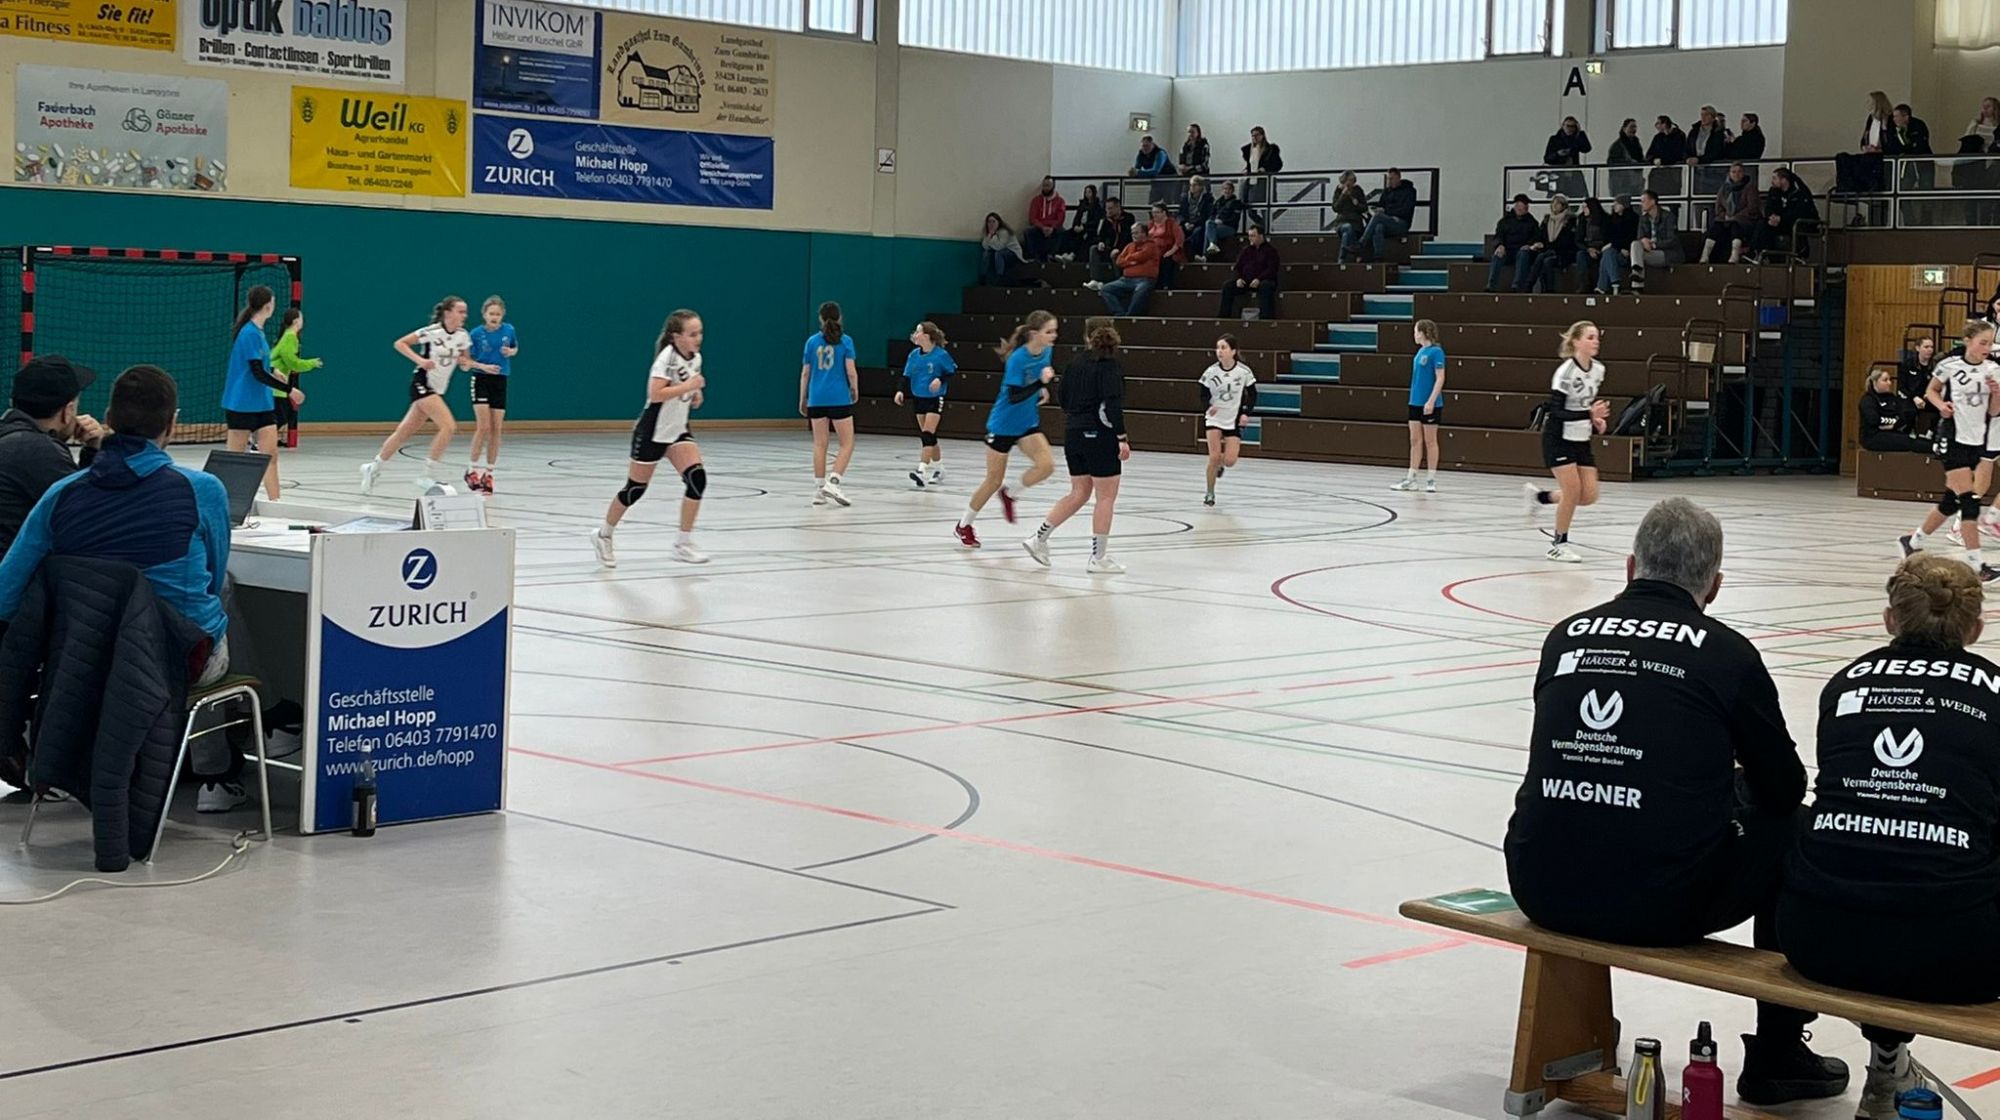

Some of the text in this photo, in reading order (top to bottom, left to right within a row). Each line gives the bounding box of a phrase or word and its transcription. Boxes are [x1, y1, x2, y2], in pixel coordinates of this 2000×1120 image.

[15, 14, 71, 35] Fitness
[97, 4, 154, 24] Sie fit!
[492, 3, 584, 36] INVIKOM
[199, 37, 235, 56] Brillen
[244, 42, 319, 65] Contactlinsen
[327, 51, 391, 72] Sportbrillen
[1563, 66, 1587, 97] A
[38, 101, 96, 116] Fauerbach
[340, 98, 425, 134] Weil KG
[40, 116, 94, 130] Apotheke
[156, 123, 208, 136] Apotheke
[357, 150, 376, 159] und
[377, 150, 433, 163] Gartenmarkt
[575, 155, 649, 174] Michael Hopp
[484, 165, 555, 187] ZURICH
[574, 171, 605, 184] Telefon
[817, 345, 835, 371] 13
[368, 600, 467, 628] ZURICH
[1566, 616, 1707, 649] GIESSEN
[1580, 654, 1627, 667] HÄUSER
[1628, 659, 1639, 668] &
[1642, 660, 1686, 679] WEBER
[1846, 658, 2000, 694] GIESSEN
[328, 685, 435, 709] Geschäftsstelle
[1867, 694, 1922, 706] HÄUSER
[1925, 697, 1935, 706] &
[1940, 697, 1988, 721] WEBER
[327, 708, 437, 732] Michael Hopp
[327, 723, 497, 754] Telefon 06403 7791470
[1575, 729, 1618, 743] Deutsche
[1551, 739, 1644, 760] Vermögensberatung
[325, 748, 474, 777] wwwzurich.de/hopp
[1870, 767, 1919, 781] Deutsche
[1542, 777, 1642, 809] WAGNER
[1842, 777, 1947, 799] Vermögensberatung
[1813, 812, 1970, 850] BACHENHEIMER
